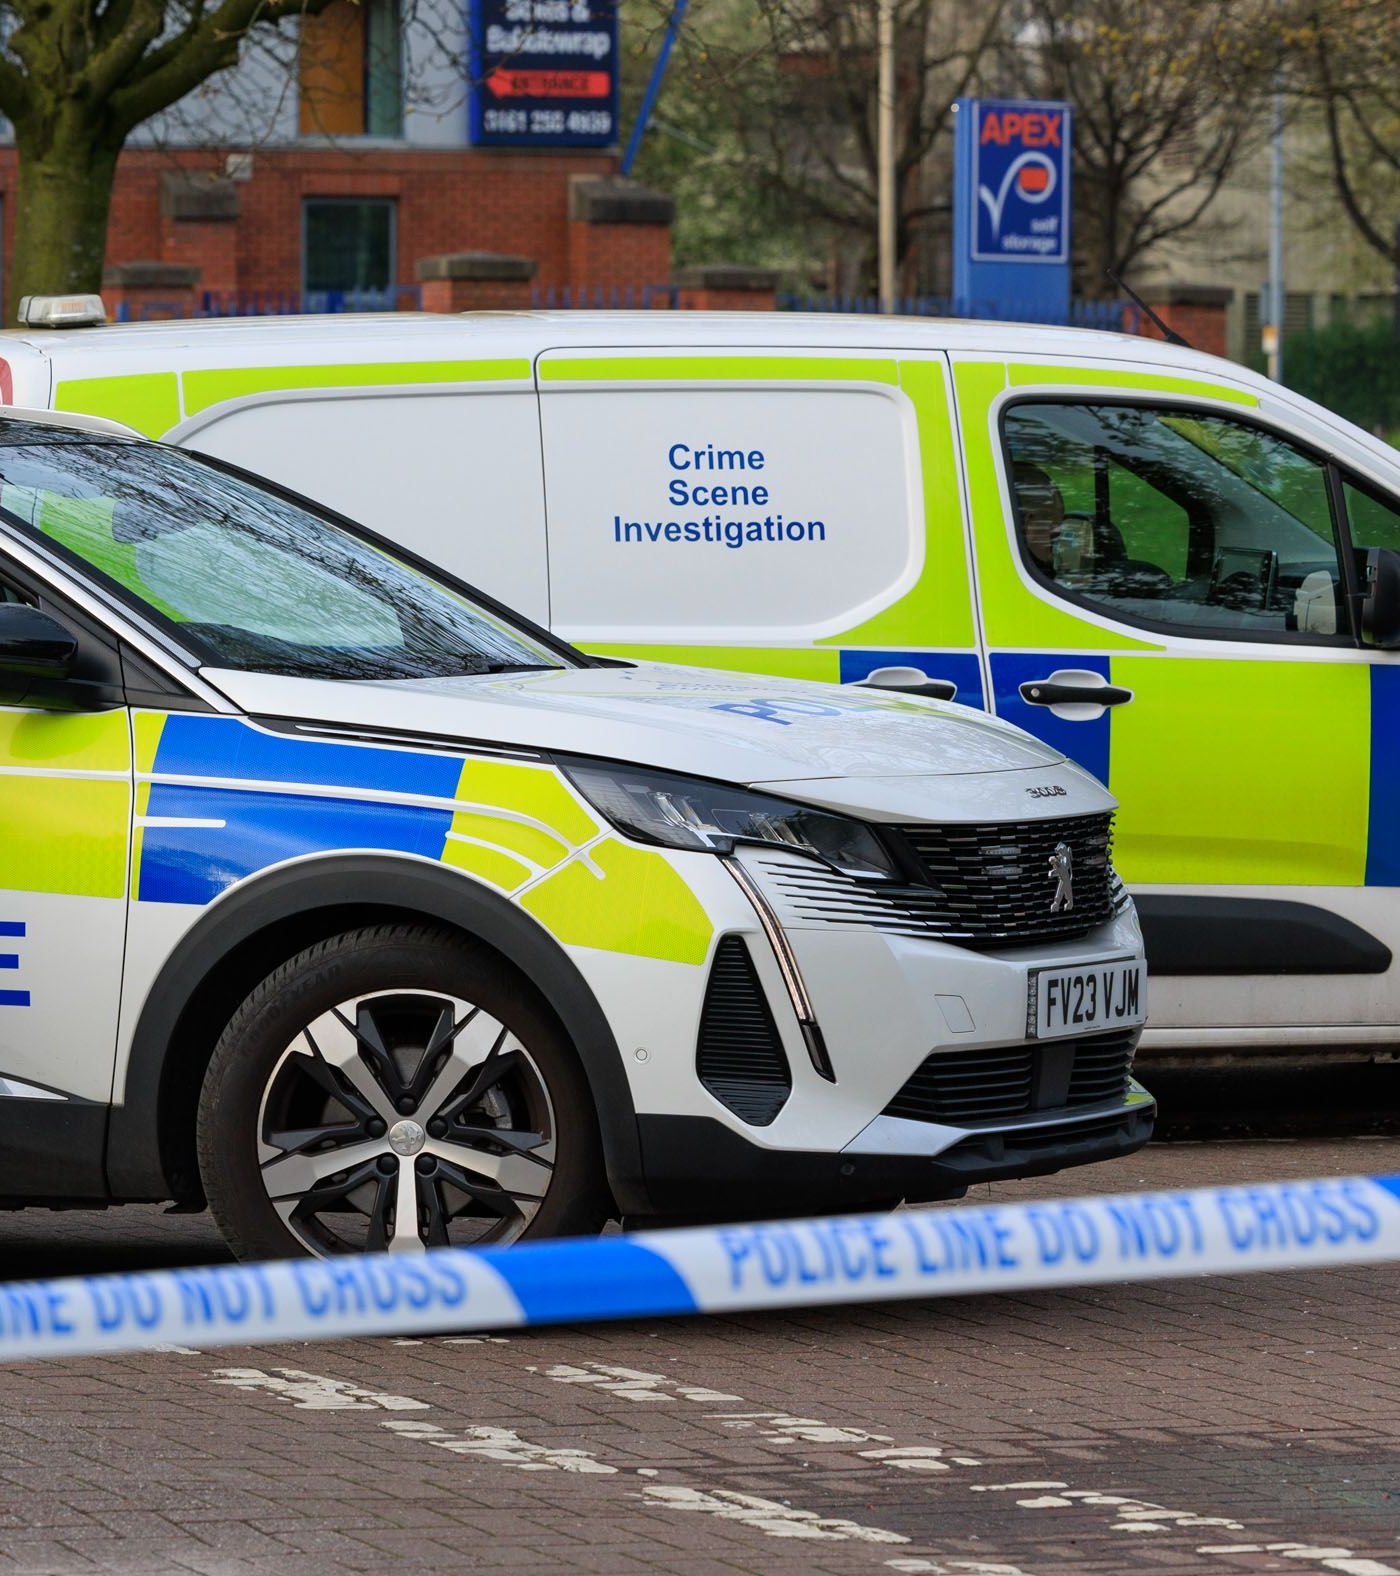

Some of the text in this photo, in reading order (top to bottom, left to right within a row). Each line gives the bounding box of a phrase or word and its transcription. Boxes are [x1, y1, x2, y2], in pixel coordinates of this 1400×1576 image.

[486, 25, 611, 60] Bubblewrap
[980, 112, 1062, 147] APEX
[1030, 215, 1059, 233] self
[1002, 234, 1058, 256] storage
[669, 443, 765, 470] Crime
[669, 479, 769, 506] Scene
[614, 515, 826, 549] Investigation
[1026, 786, 1067, 798] 3008
[1047, 967, 1140, 1028] FV23 VJM
[717, 1178, 1380, 1291] POLICE LINE DO NOT CROSS
[85, 1272, 165, 1333] DO
[171, 1263, 276, 1326] NOT
[292, 1254, 470, 1319] CROSS
